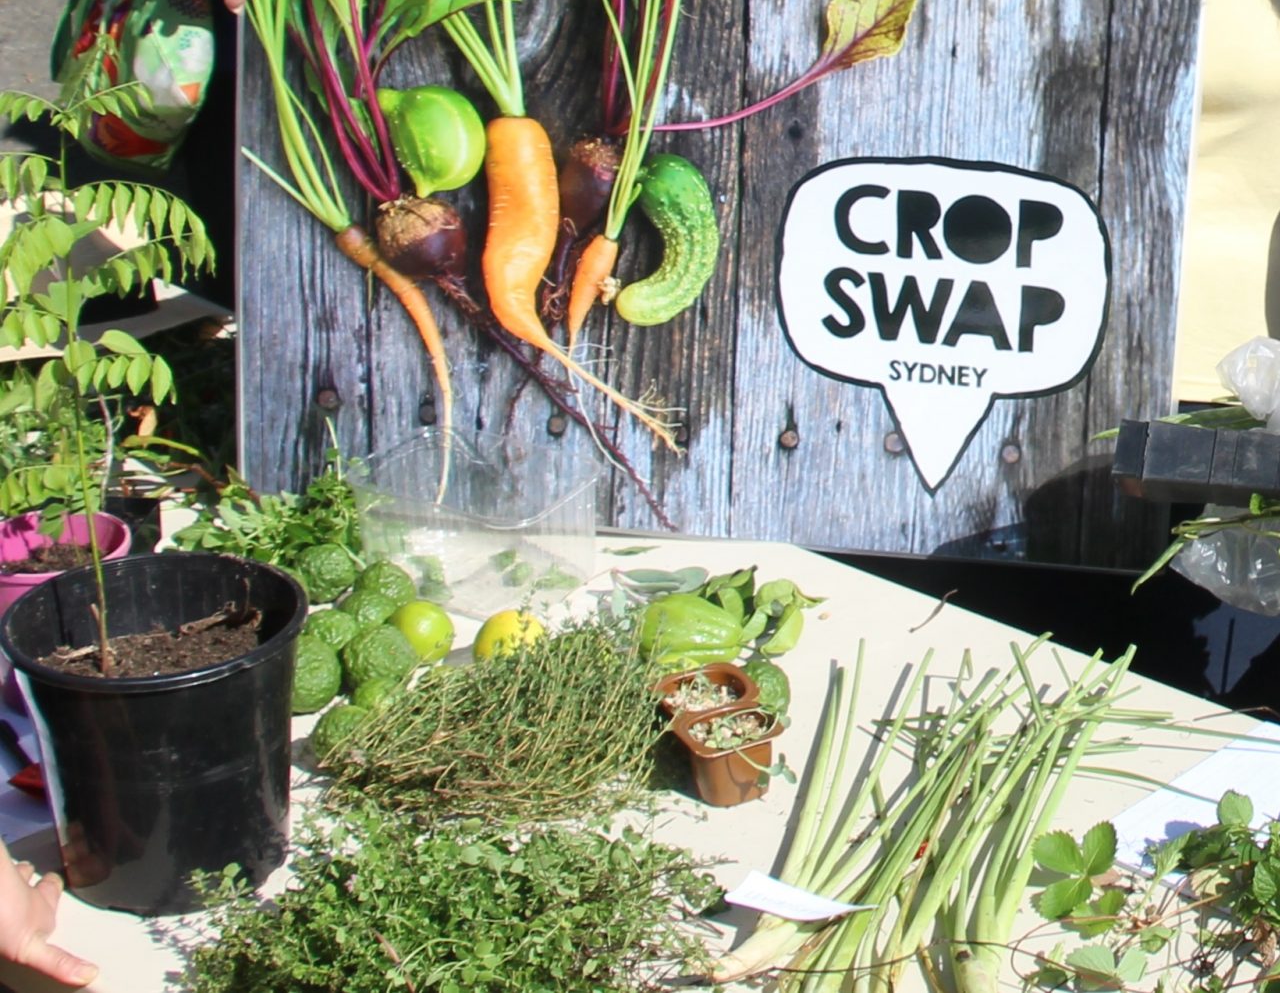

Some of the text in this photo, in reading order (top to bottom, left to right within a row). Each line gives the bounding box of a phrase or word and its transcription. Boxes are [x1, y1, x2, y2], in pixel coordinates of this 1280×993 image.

[833, 183, 1064, 269] CROP
[821, 266, 1066, 354] SWAP
[888, 359, 989, 388] SYDNEY
